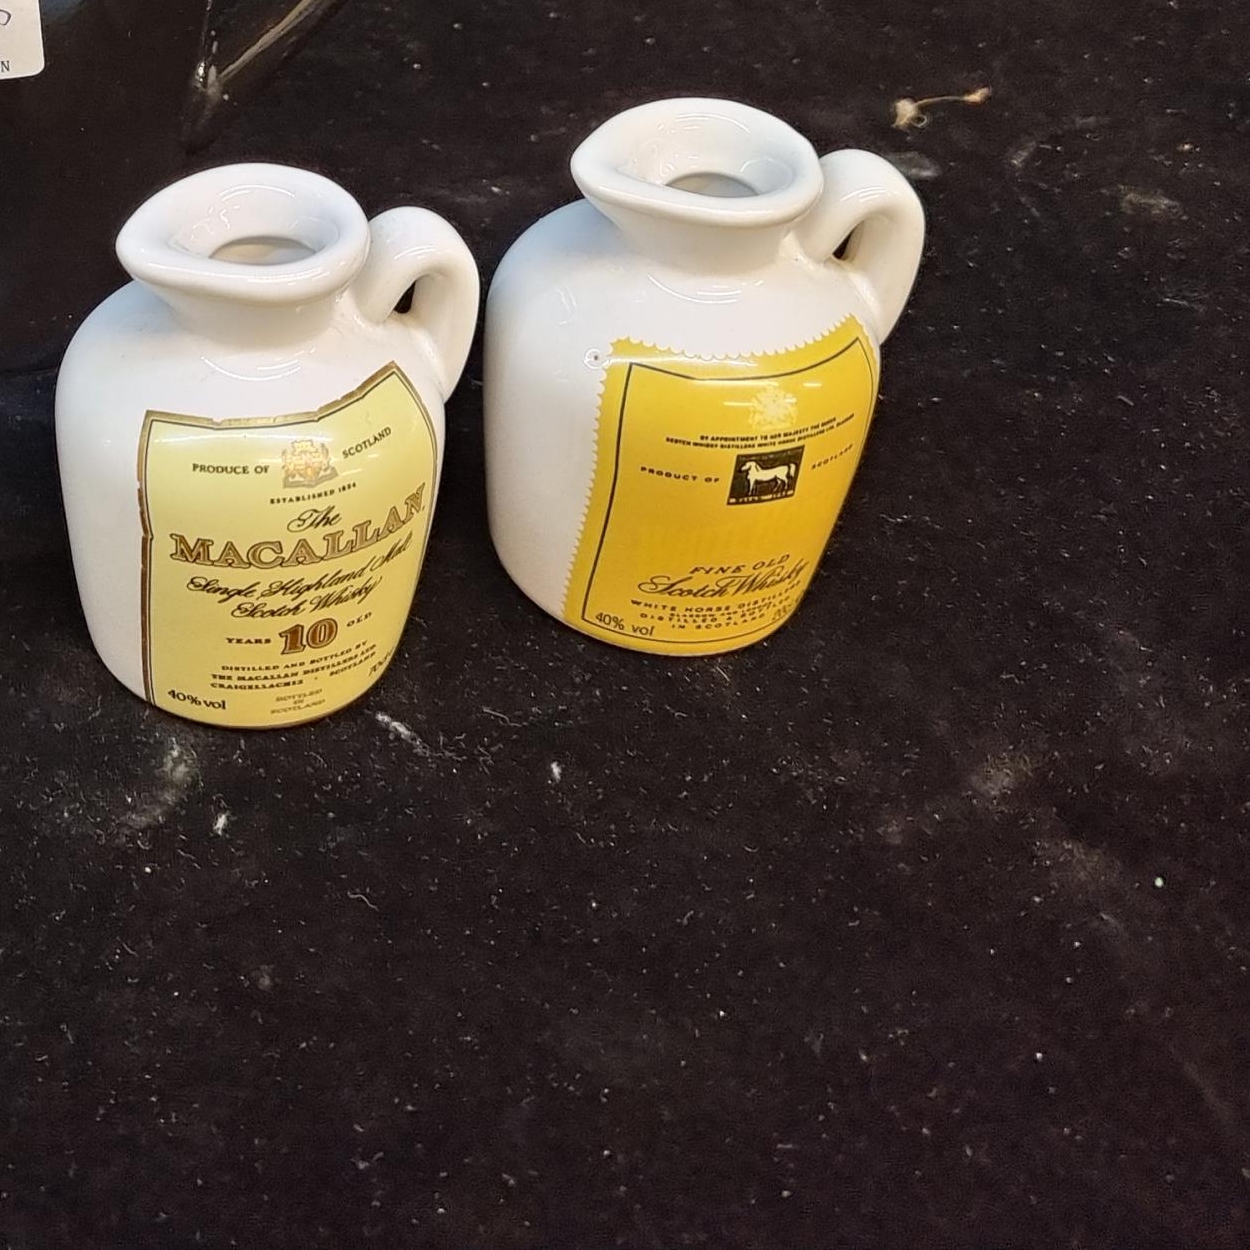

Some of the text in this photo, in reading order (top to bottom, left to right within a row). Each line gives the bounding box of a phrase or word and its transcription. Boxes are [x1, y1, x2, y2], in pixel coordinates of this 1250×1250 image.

[341, 426, 392, 460] SCOTLAND
[191, 462, 270, 475] PRODUCE OF
[811, 443, 854, 470] SCOTLAND
[639, 466, 720, 484] PRODUCT OF
[270, 489, 336, 504] ESTABLISHED
[169, 482, 427, 570] MACALLAN
[286, 505, 343, 533] The
[752, 553, 790, 571] OLD
[186, 576, 261, 604] Single
[258, 556, 378, 602] Highland
[637, 575, 732, 599] Scotch
[230, 575, 384, 619] Scotch Whisky
[631, 599, 677, 612] WHITE
[684, 605, 731, 613] HORSE
[595, 611, 655, 637] 40% vol
[639, 612, 718, 624] DISTILLED
[694, 613, 766, 630] SCOTLAND
[225, 611, 373, 655] YEARS 10 OLD
[221, 664, 280, 672] DISTILLED
[283, 661, 306, 669] AND
[309, 647, 353, 665] BOTTLED
[236, 671, 300, 681] MACALLAN
[167, 688, 227, 710] 40% vol
